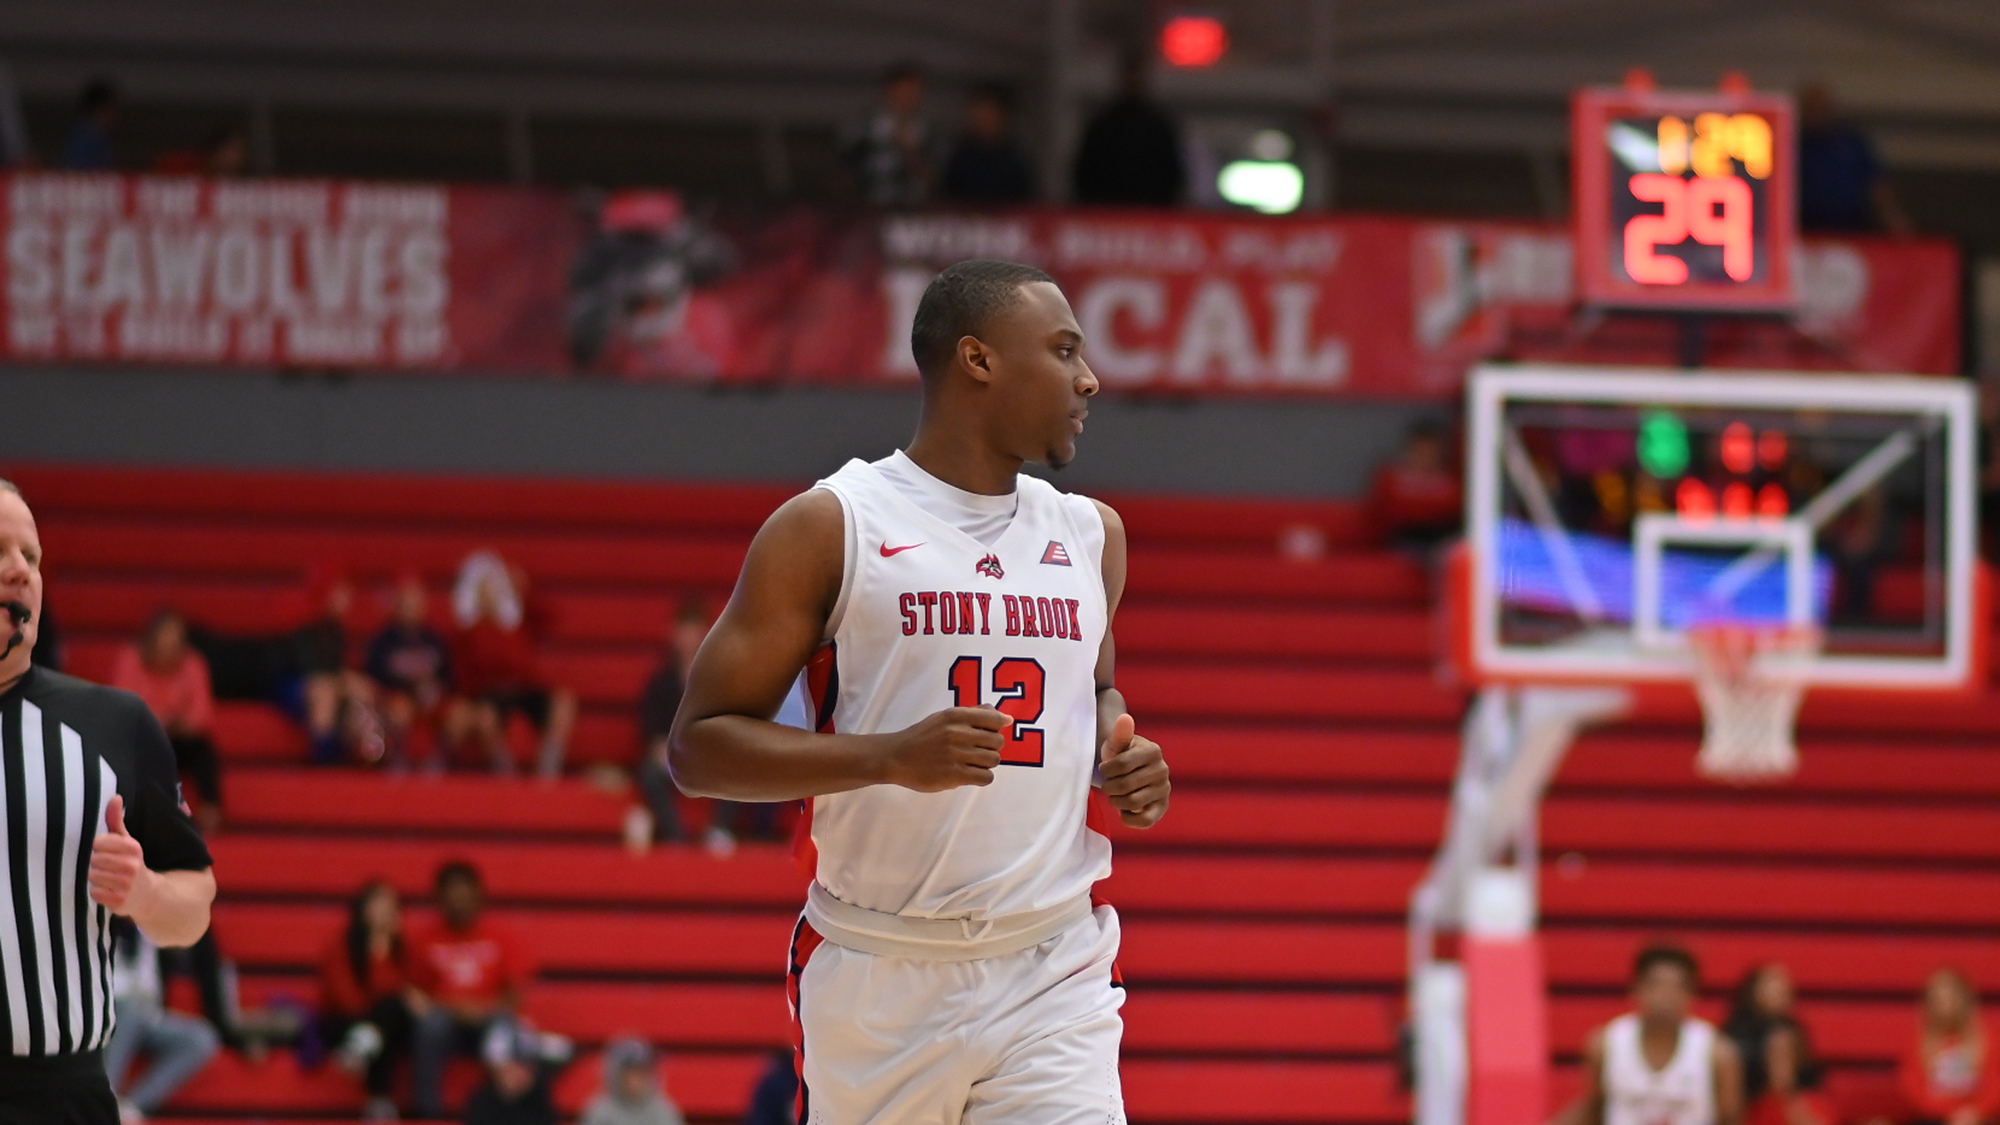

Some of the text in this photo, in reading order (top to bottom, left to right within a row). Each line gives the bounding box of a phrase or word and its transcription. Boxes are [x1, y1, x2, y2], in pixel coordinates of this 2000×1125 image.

[8, 221, 448, 317] SEAWOLVES
[1623, 174, 1755, 285] 29
[886, 271, 1349, 386] CAL
[899, 590, 1082, 641] STONY BROOK
